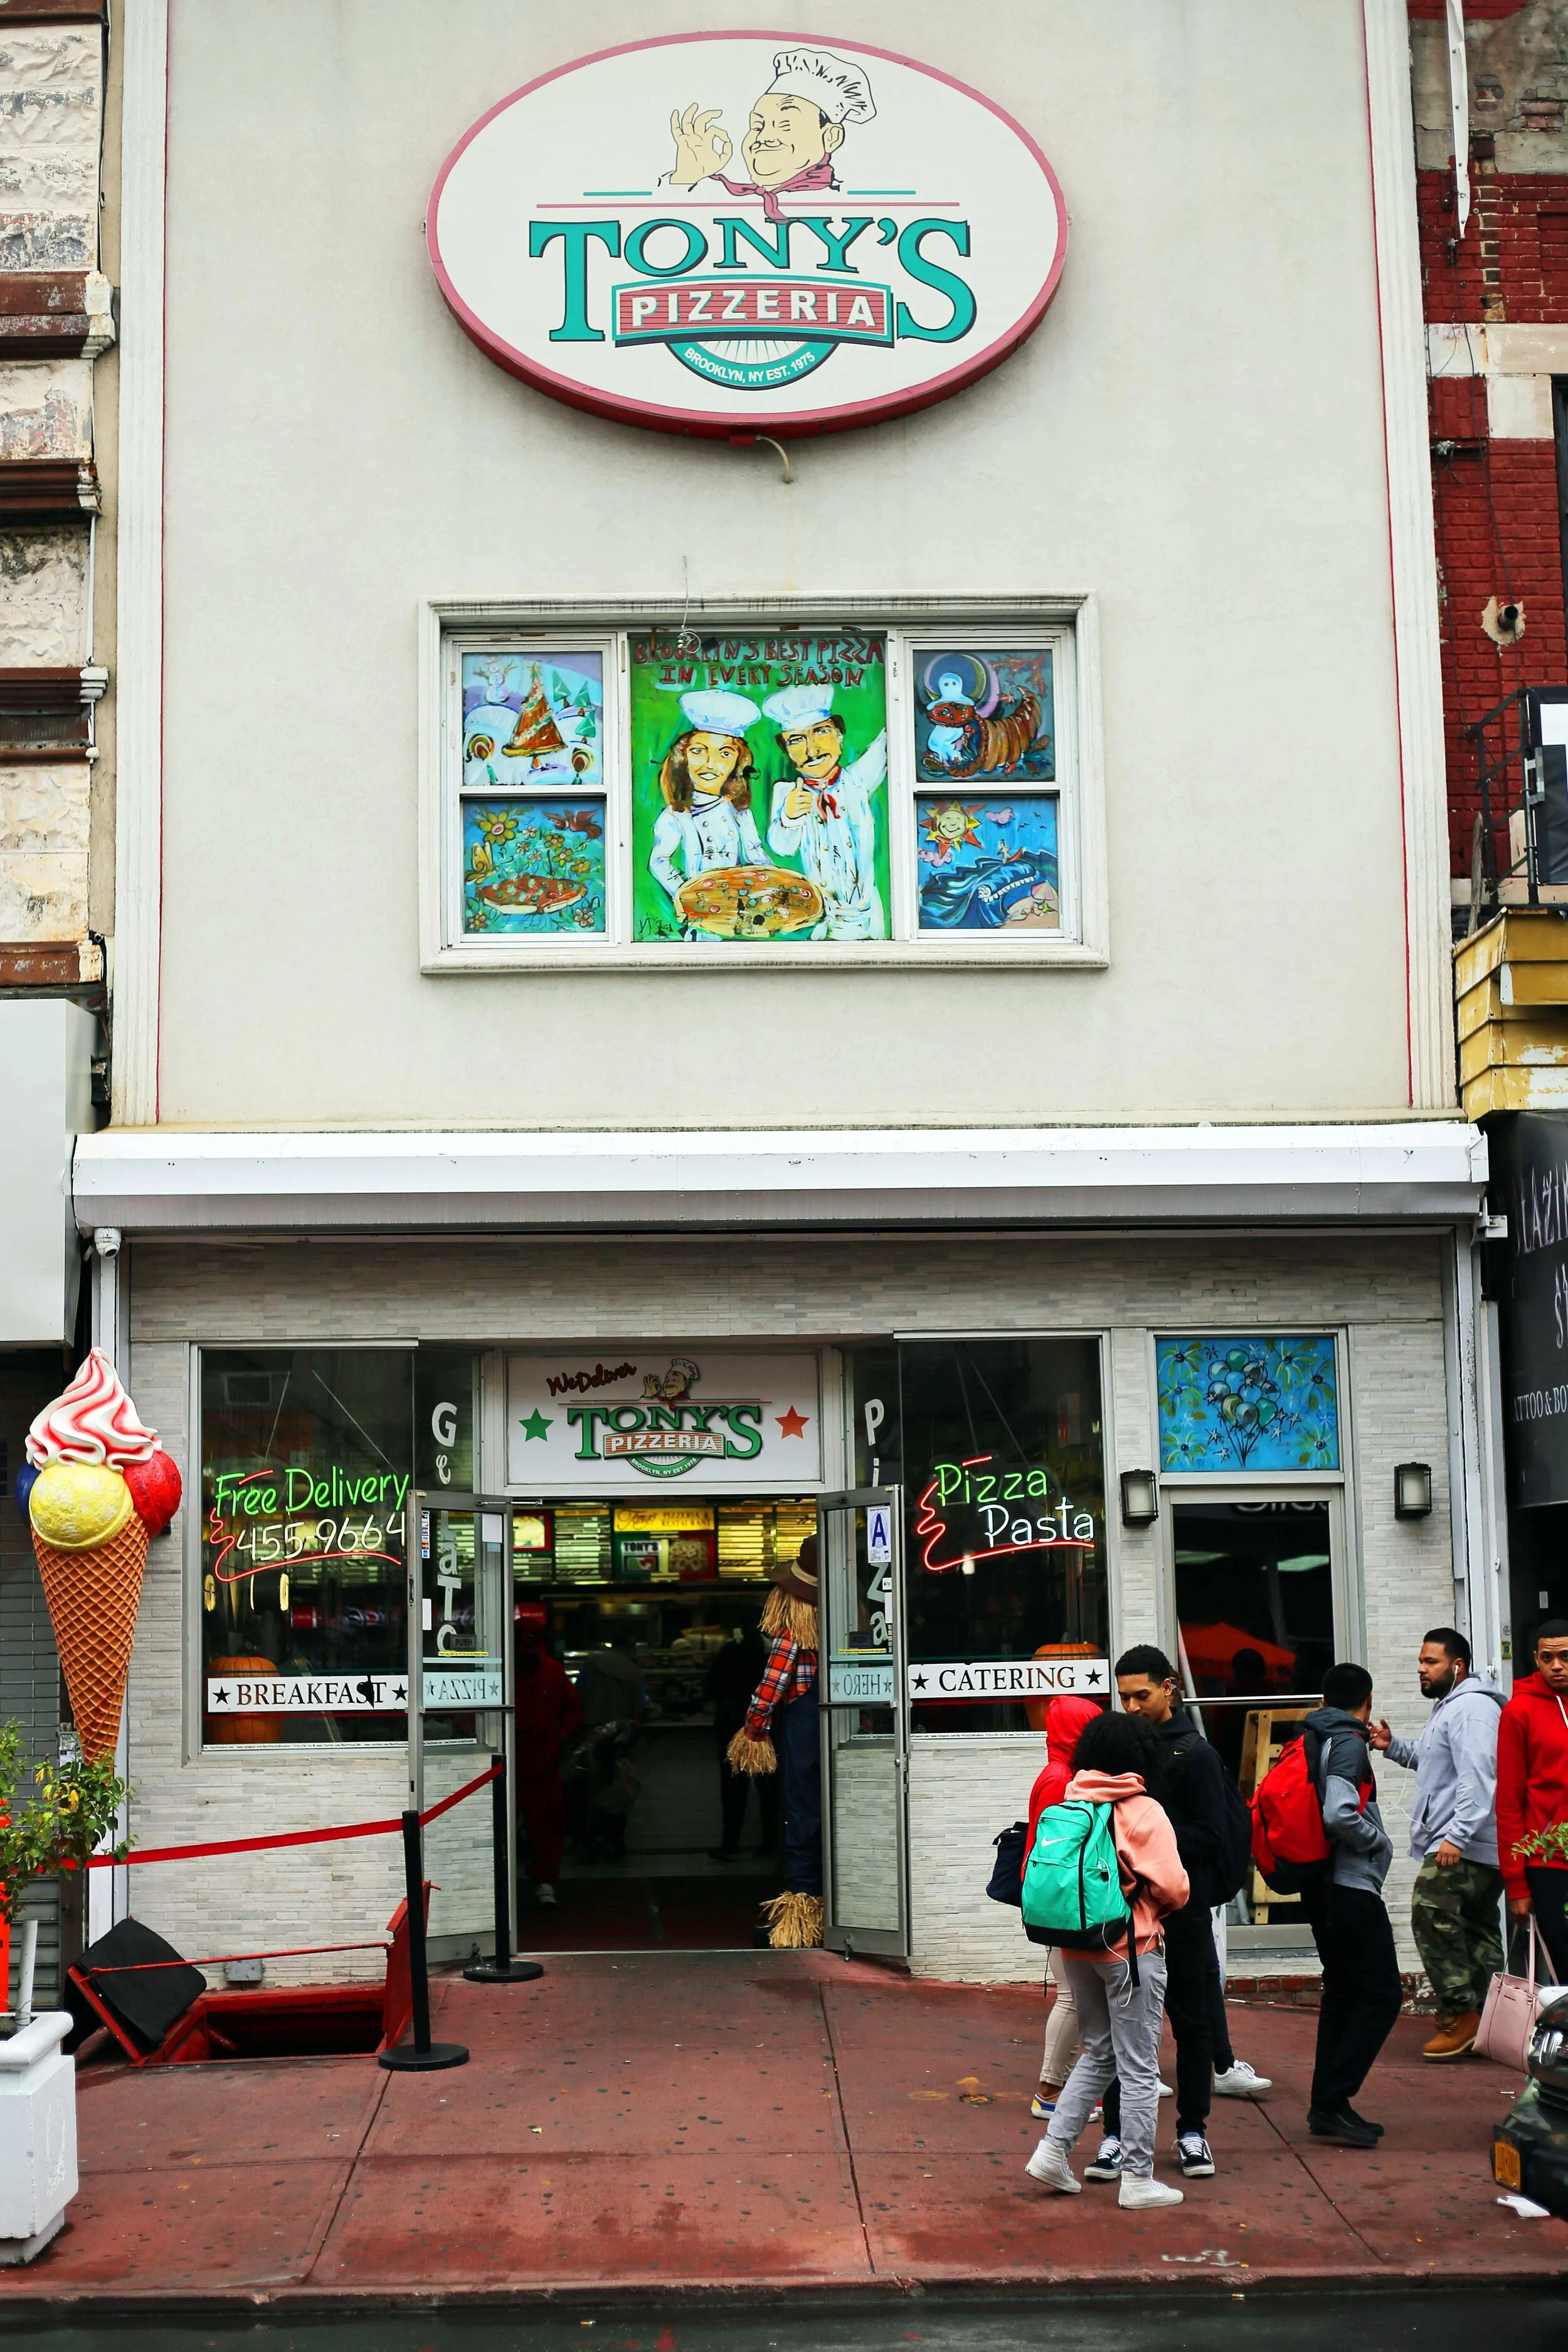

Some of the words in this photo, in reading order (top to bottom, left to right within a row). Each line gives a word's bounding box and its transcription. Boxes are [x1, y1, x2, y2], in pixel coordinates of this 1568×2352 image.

[529, 217, 977, 343] TONY'S
[632, 290, 876, 328] PIZZERIA
[684, 347, 746, 384] BROOKLYN,
[748, 370, 765, 382] NY
[766, 365, 790, 381] EST.
[791, 351, 815, 371] 1975
[764, 638, 811, 662] BEST
[817, 637, 885, 664] PIZZA
[660, 665, 694, 684] IN
[707, 664, 772, 685] EVERY
[776, 664, 864, 687] SEASON
[1513, 1390, 1544, 1422] ATTOO
[567, 1405, 763, 1459] TONY'S
[611, 1434, 718, 1452] PIZZERIA
[631, 1458, 662, 1475] BROOKLYN,
[685, 1458, 697, 1468] 1975
[215, 1473, 277, 1518] Free
[285, 1465, 410, 1512] Delivery
[935, 1464, 1047, 1507] Pizza
[236, 1511, 406, 1561] 455-9664
[871, 1513, 887, 1547] A
[978, 1496, 1094, 1548] Pasta
[455, 1638, 472, 1646] PUSH
[236, 1682, 387, 1705] BREAKFAST
[939, 1666, 1076, 1692] CATERING
